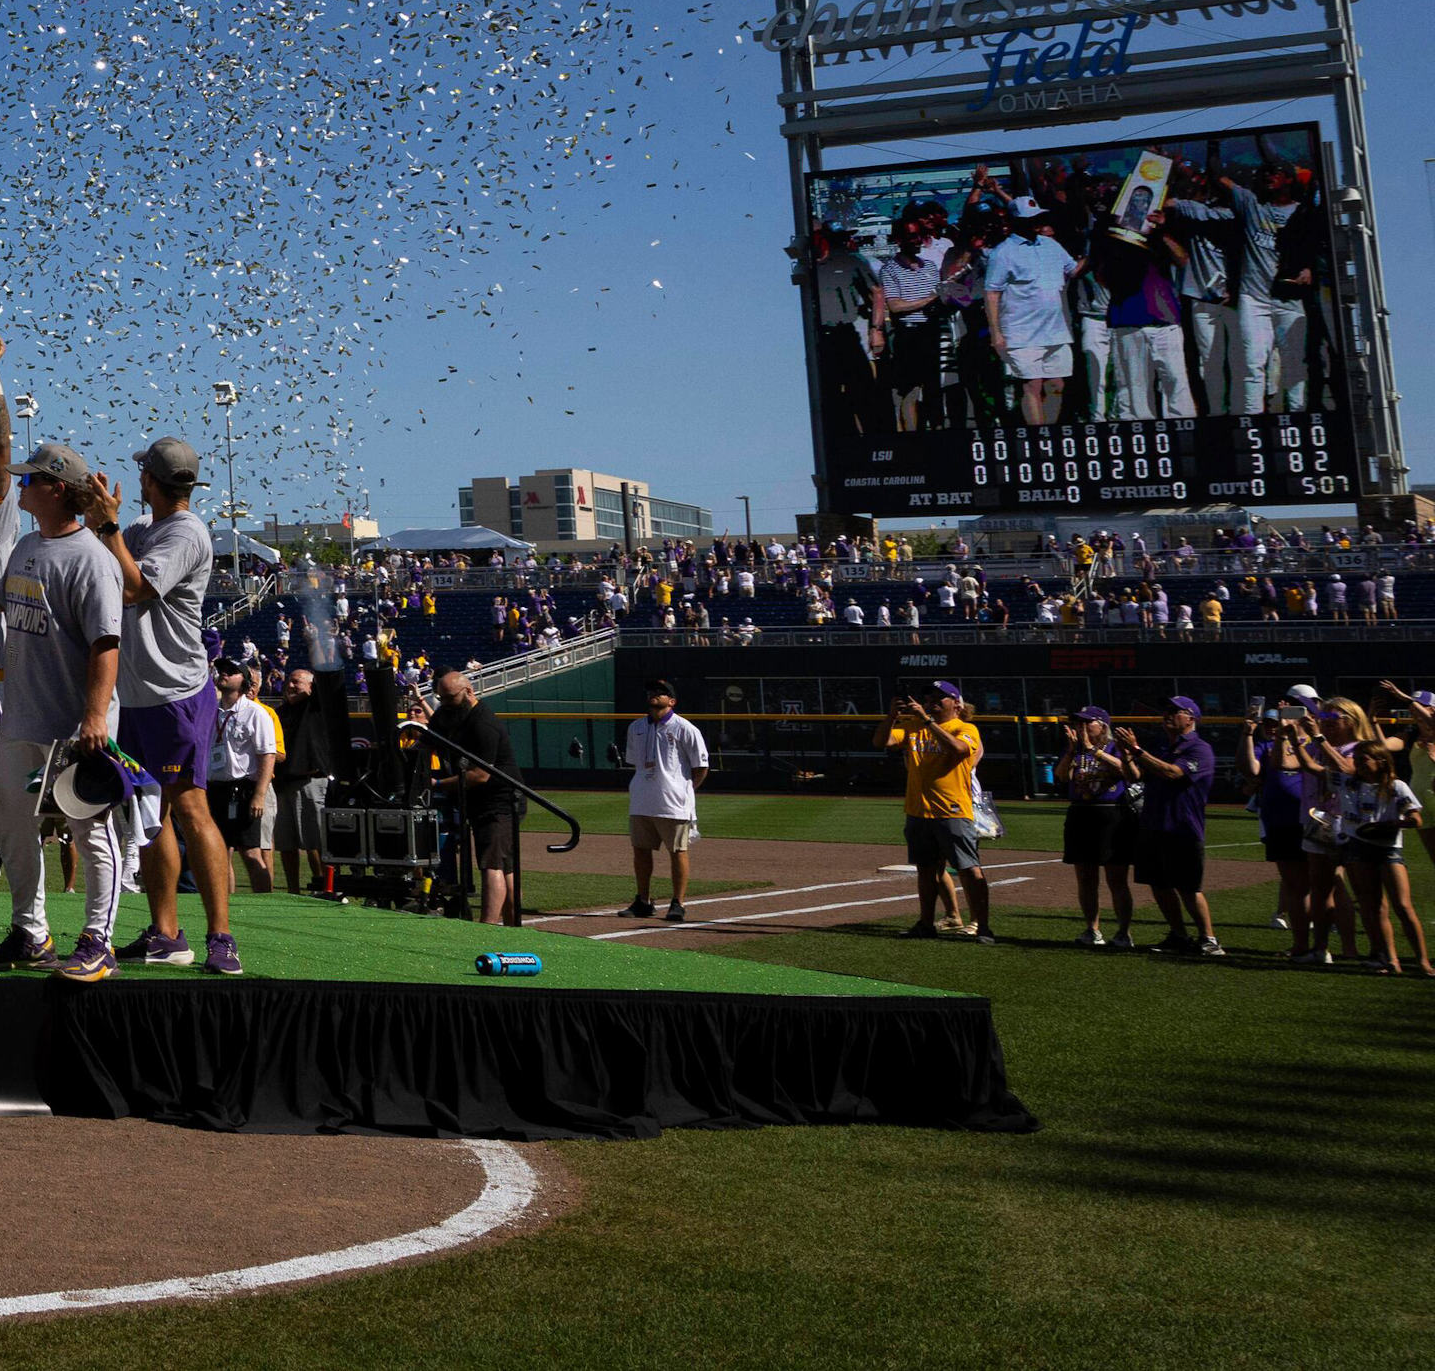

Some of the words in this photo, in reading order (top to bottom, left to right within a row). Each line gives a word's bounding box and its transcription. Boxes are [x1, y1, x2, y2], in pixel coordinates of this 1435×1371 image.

[967, 11, 1141, 112] field
[998, 81, 1122, 114] OMAHA
[972, 429, 982, 441] 1
[994, 428, 1005, 440] 2
[1016, 427, 1027, 439] 3
[1039, 426, 1051, 437] 4
[1061, 425, 1073, 437] 5
[1085, 424, 1096, 435] 6
[1108, 422, 1120, 434] 7
[1132, 421, 1143, 433] 8
[1155, 420, 1167, 432] 9
[1174, 419, 1196, 431] 10
[1239, 416, 1252, 428] R
[1278, 415, 1291, 426] H
[1311, 413, 1323, 424] E
[871, 450, 894, 462] LSU
[972, 441, 985, 462] 0
[994, 440, 1007, 461] 0
[1024, 440, 1030, 458] 1
[1039, 439, 1053, 458] 4
[1062, 437, 1076, 458] 0
[1085, 436, 1099, 457] 0
[1108, 435, 1122, 456] 0
[1132, 434, 1146, 455] 0
[1155, 433, 1170, 454] 0
[1247, 428, 1262, 449] 5
[1281, 426, 1301, 448] 10
[1311, 425, 1326, 447] 0
[844, 476, 881, 487] COASTAL
[883, 475, 925, 486] CAROLINA
[974, 464, 987, 485] 0
[1004, 464, 1010, 483] 1
[1019, 463, 1032, 483] 0
[1042, 462, 1055, 483] 0
[1065, 461, 1078, 482] 0
[1087, 459, 1101, 481] 0
[1111, 459, 1124, 480] 2
[1134, 458, 1148, 479] 0
[1158, 457, 1172, 478] 0
[1251, 453, 1265, 474] 3
[1289, 451, 1304, 473] 8
[1314, 450, 1329, 472] 2
[908, 493, 933, 507] AT
[936, 491, 973, 505] BAT
[1018, 488, 1066, 503] BALL
[1066, 485, 1081, 504] 0
[1100, 484, 1172, 500] STRIKE
[1173, 481, 1187, 500] 0
[1209, 481, 1249, 496] OUT
[1250, 478, 1266, 497] 0
[1302, 474, 1350, 495] 5:07
[844, 565, 866, 577] 135
[1336, 555, 1363, 567] 136
[434, 575, 453, 586] 134
[899, 653, 949, 667] #MCWS
[1050, 648, 1138, 670] ESPN
[1244, 653, 1309, 666] NCAA.com
[162, 764, 181, 774] LSU
